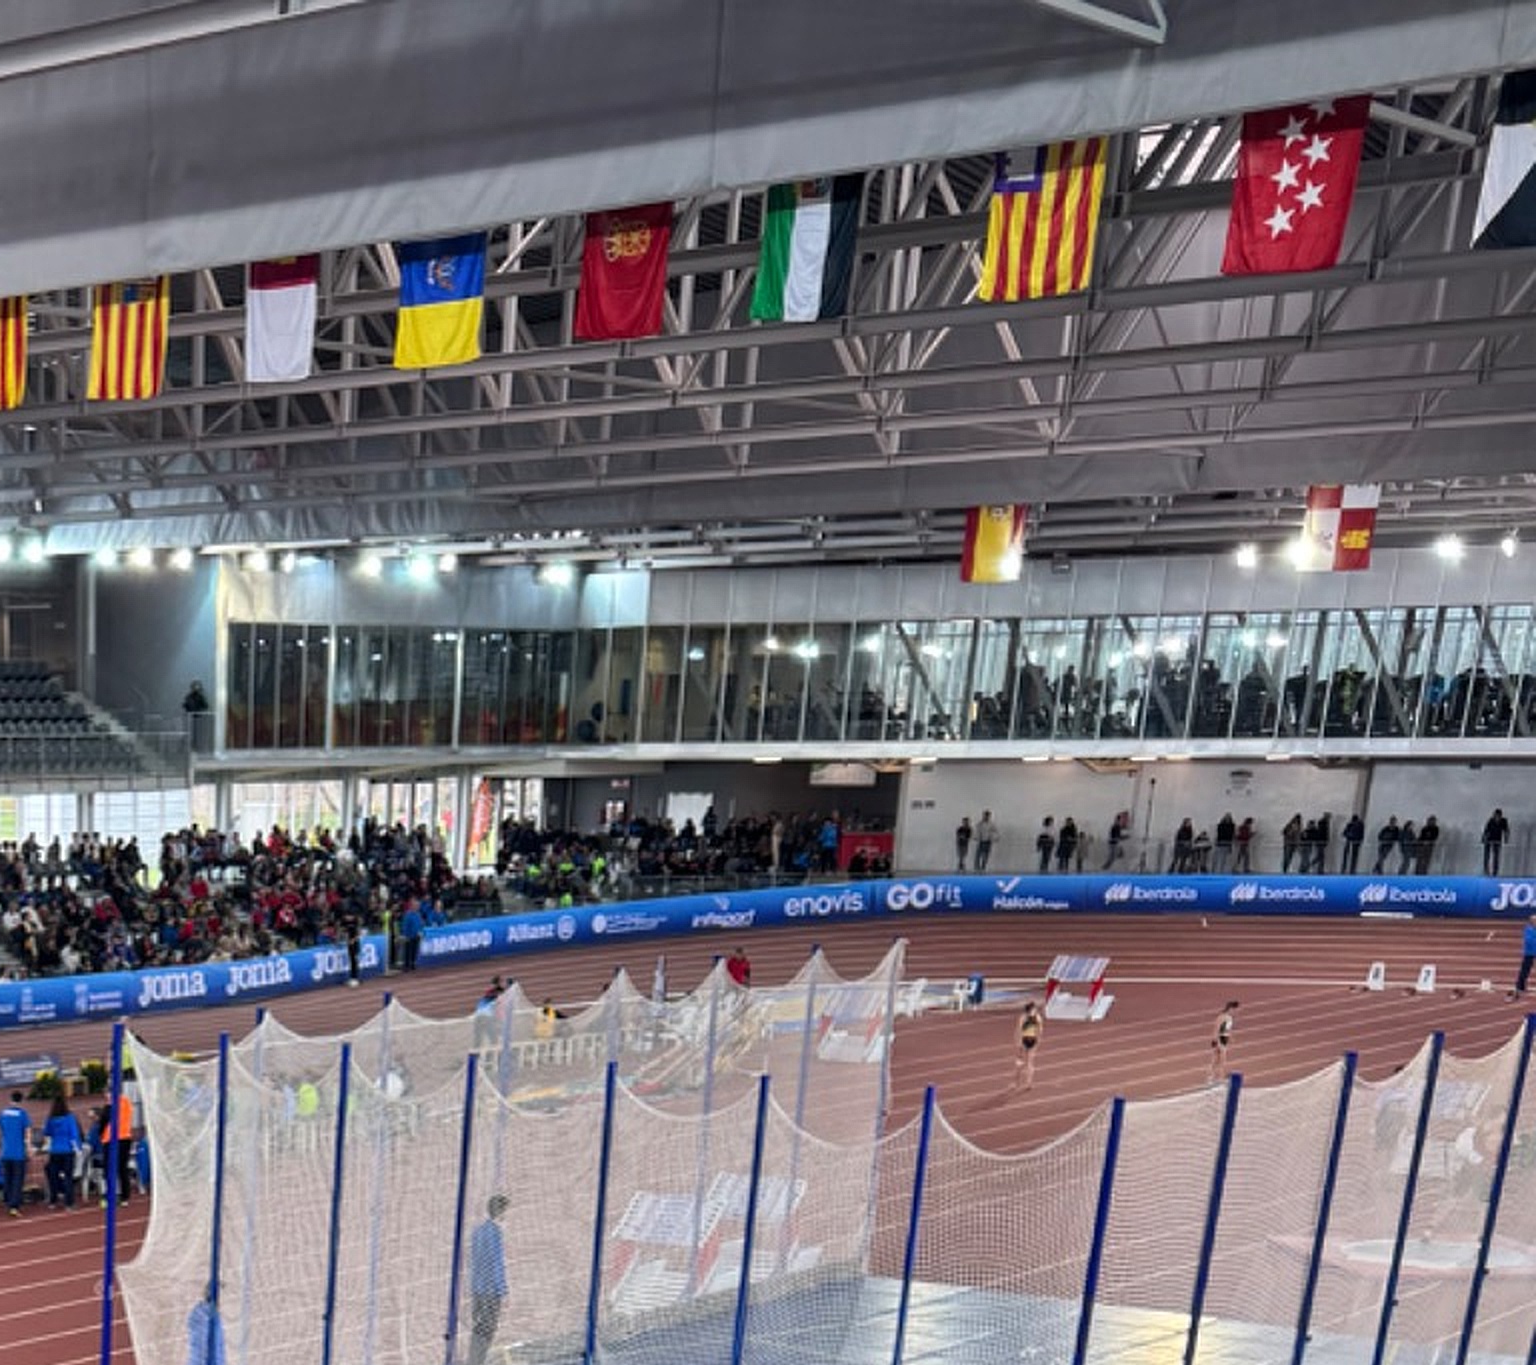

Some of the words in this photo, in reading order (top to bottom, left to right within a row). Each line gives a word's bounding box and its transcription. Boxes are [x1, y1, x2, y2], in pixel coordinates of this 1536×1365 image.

[784, 889, 864, 917] enovis
[1133, 884, 1198, 901] Iberdrola
[1259, 884, 1325, 901] Iberdrola
[1389, 885, 1457, 902] Iberdrola
[1490, 883, 1536, 911] Jo
[138, 971, 207, 1008] Joma
[225, 957, 292, 997] Joma
